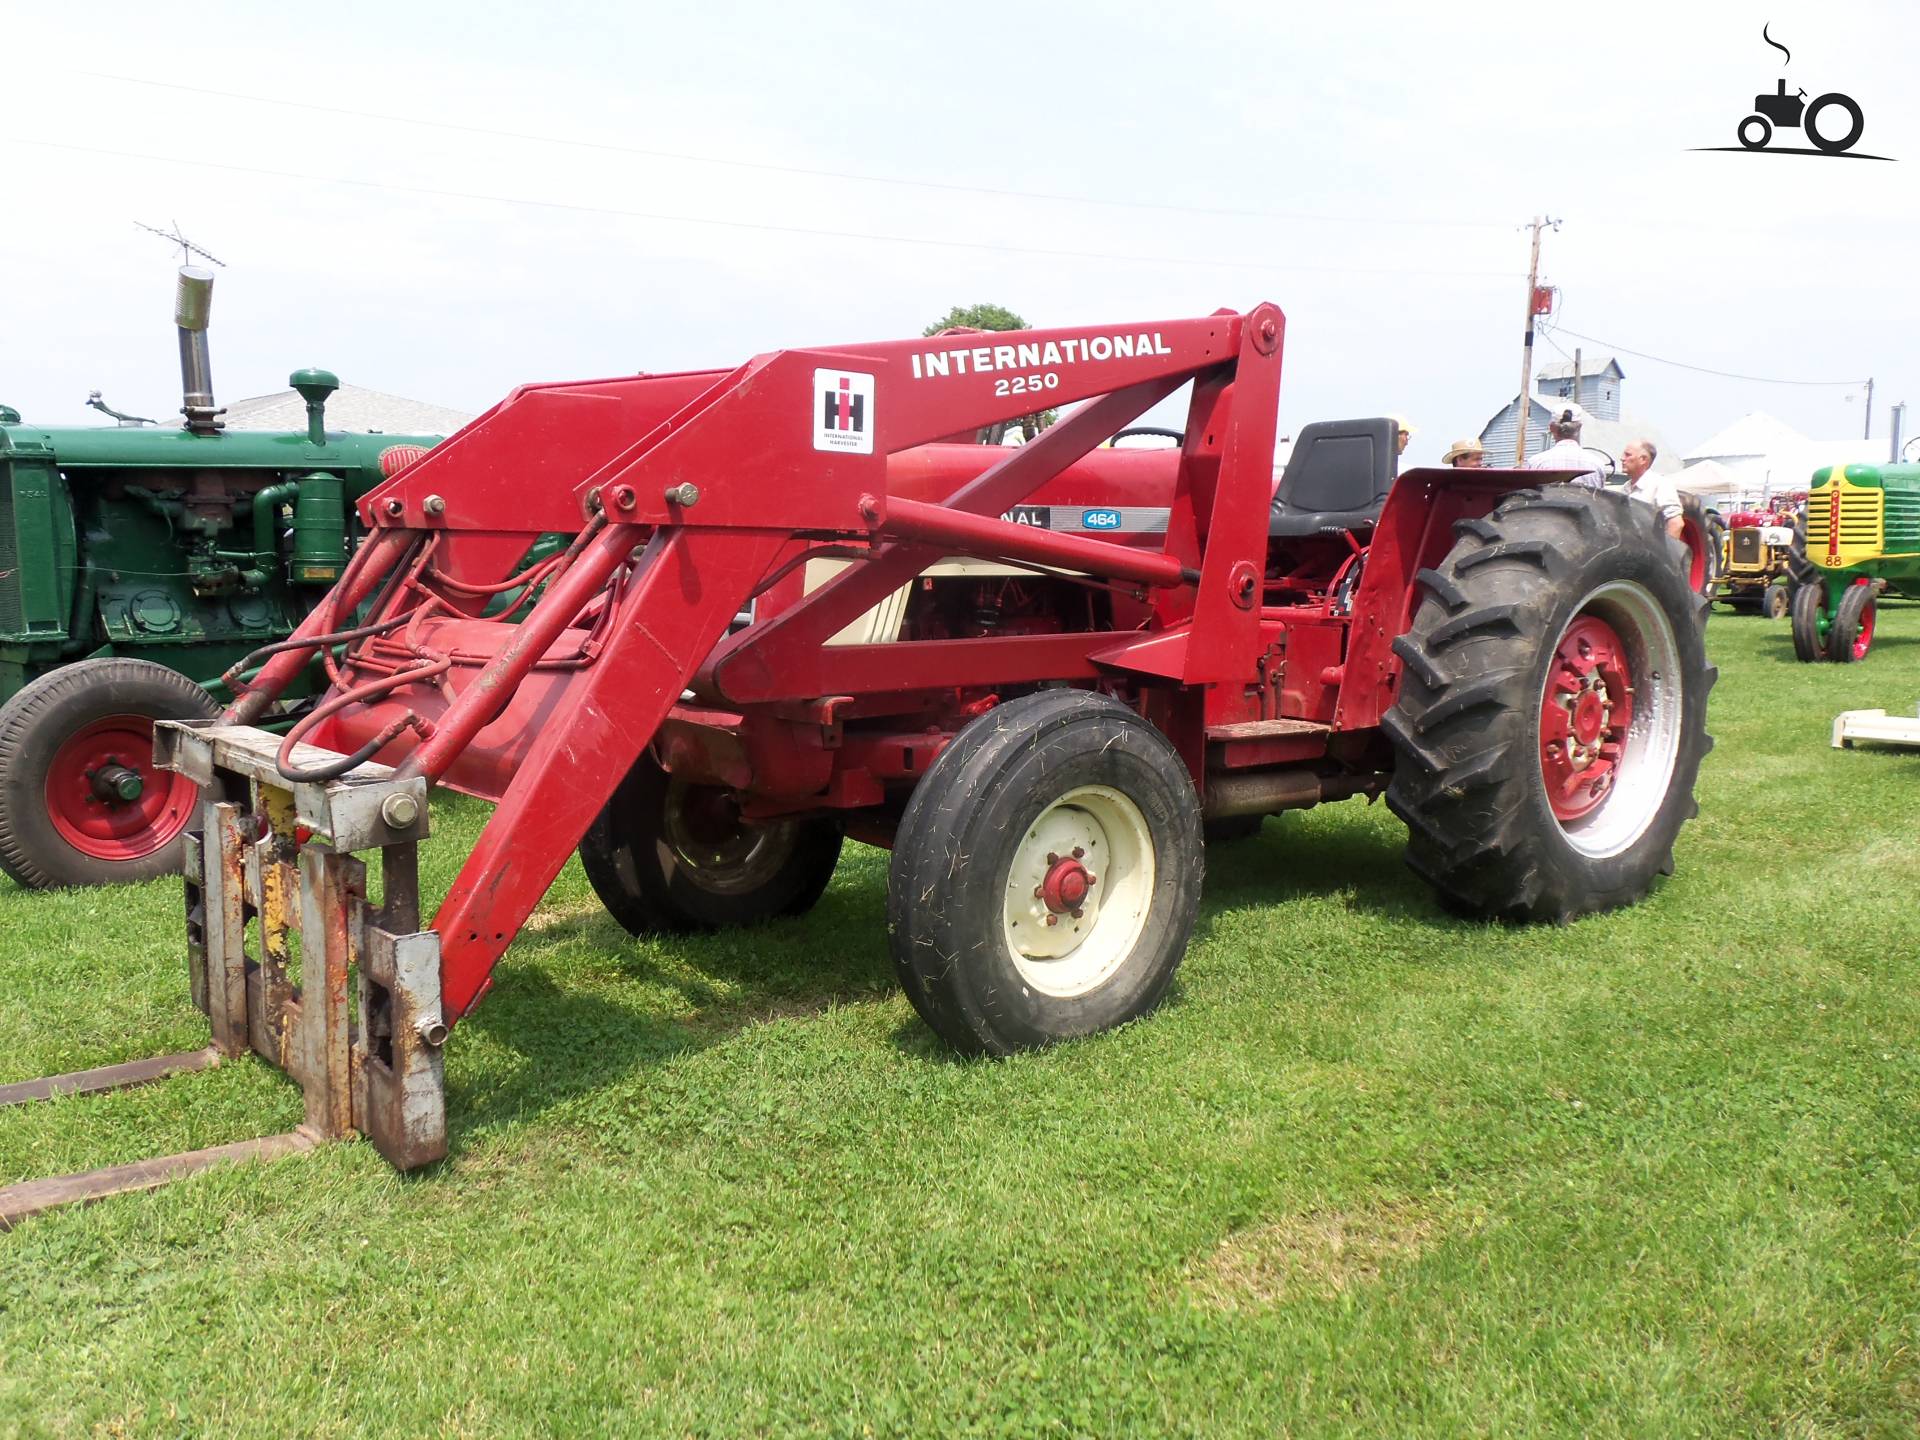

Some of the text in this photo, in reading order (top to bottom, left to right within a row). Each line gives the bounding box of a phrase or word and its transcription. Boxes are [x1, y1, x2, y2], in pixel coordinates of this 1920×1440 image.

[911, 333, 1172, 378] INTERNATIONAL
[994, 372, 1059, 396] 2250
[824, 433, 864, 441] INTERNATIONAL
[1087, 513, 1117, 525] 464
[1825, 556, 1842, 567] 88
